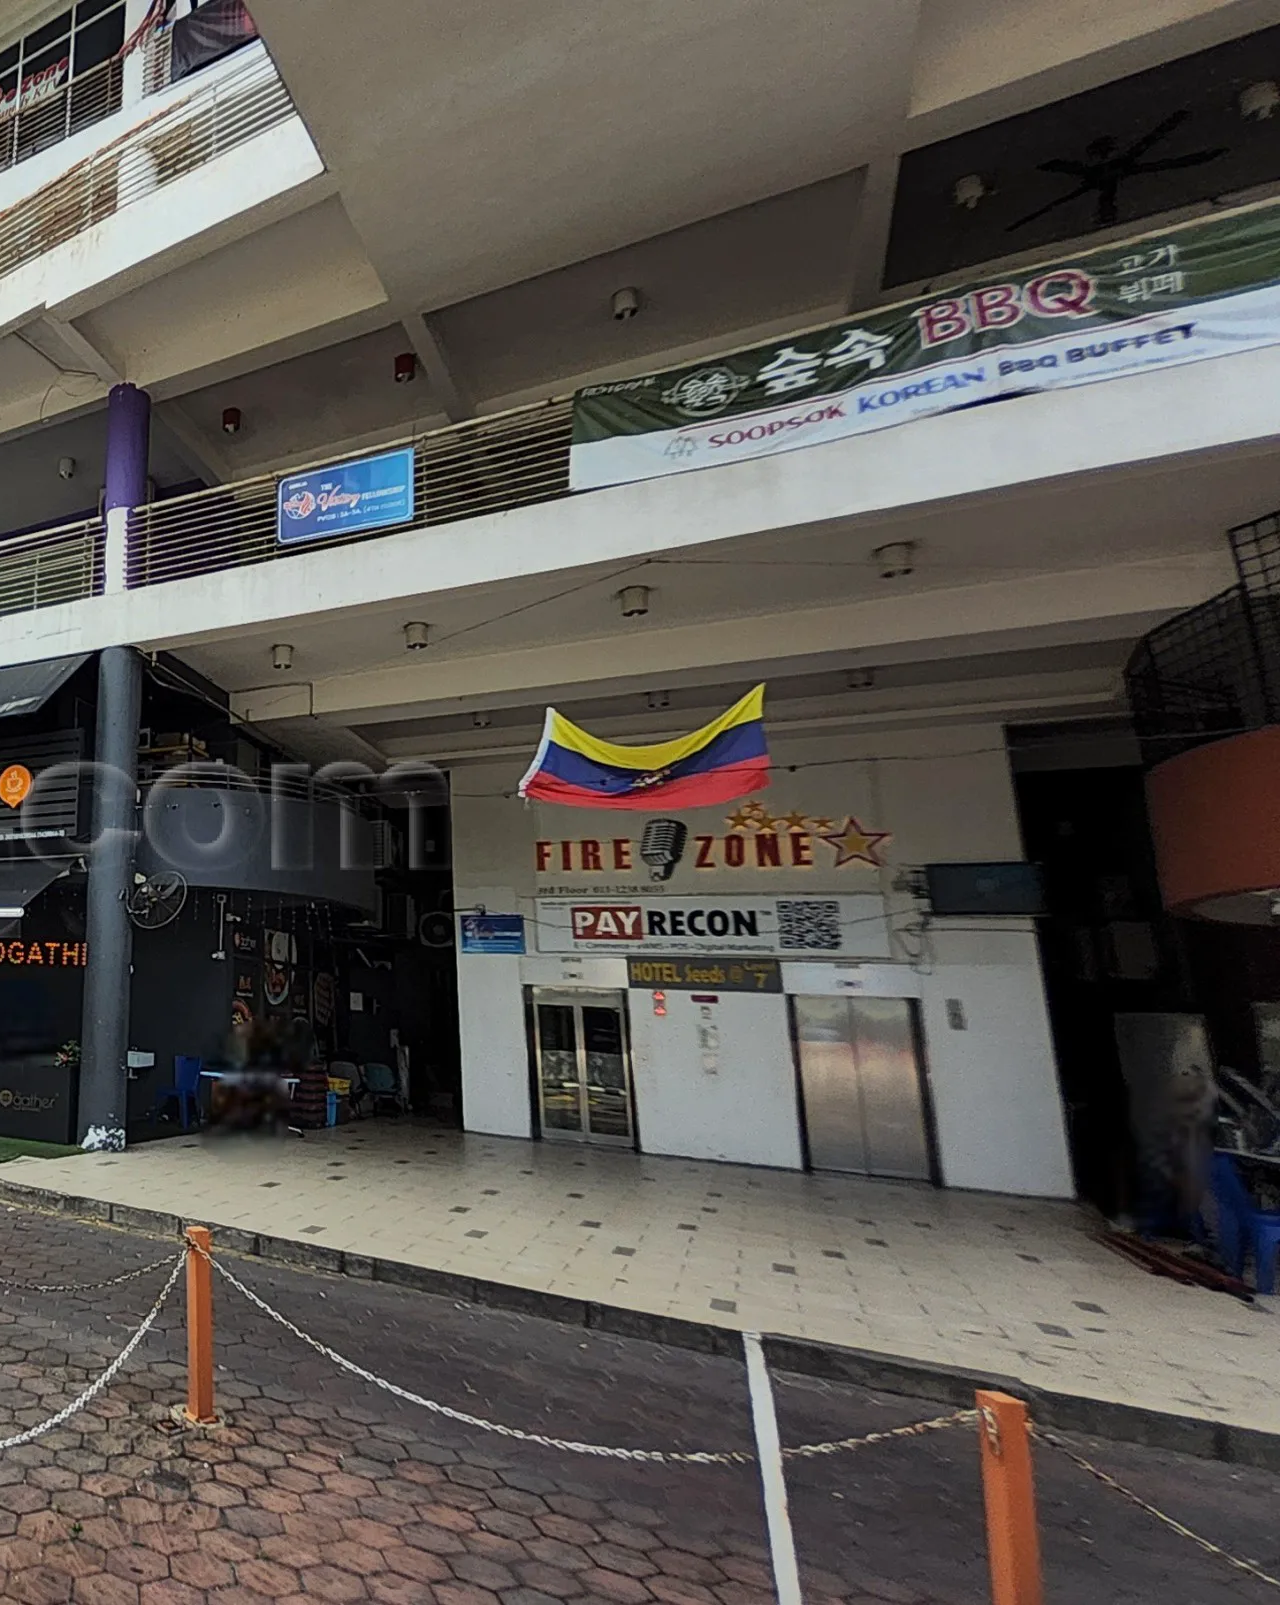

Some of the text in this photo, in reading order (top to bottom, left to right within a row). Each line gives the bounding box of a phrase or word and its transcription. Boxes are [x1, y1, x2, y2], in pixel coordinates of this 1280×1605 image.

[919, 268, 1100, 350] BBQ
[756, 328, 895, 397] 숲속
[708, 402, 847, 448] SOOPSOK
[857, 366, 987, 414] KOREAN
[998, 353, 1059, 377] BBQ
[1065, 320, 1199, 364] BUFFET
[535, 832, 814, 872] FIRE ZONE
[559, 886, 589, 895] Floor
[631, 962, 683, 982] HOTEL
[753, 973, 769, 988] 7
